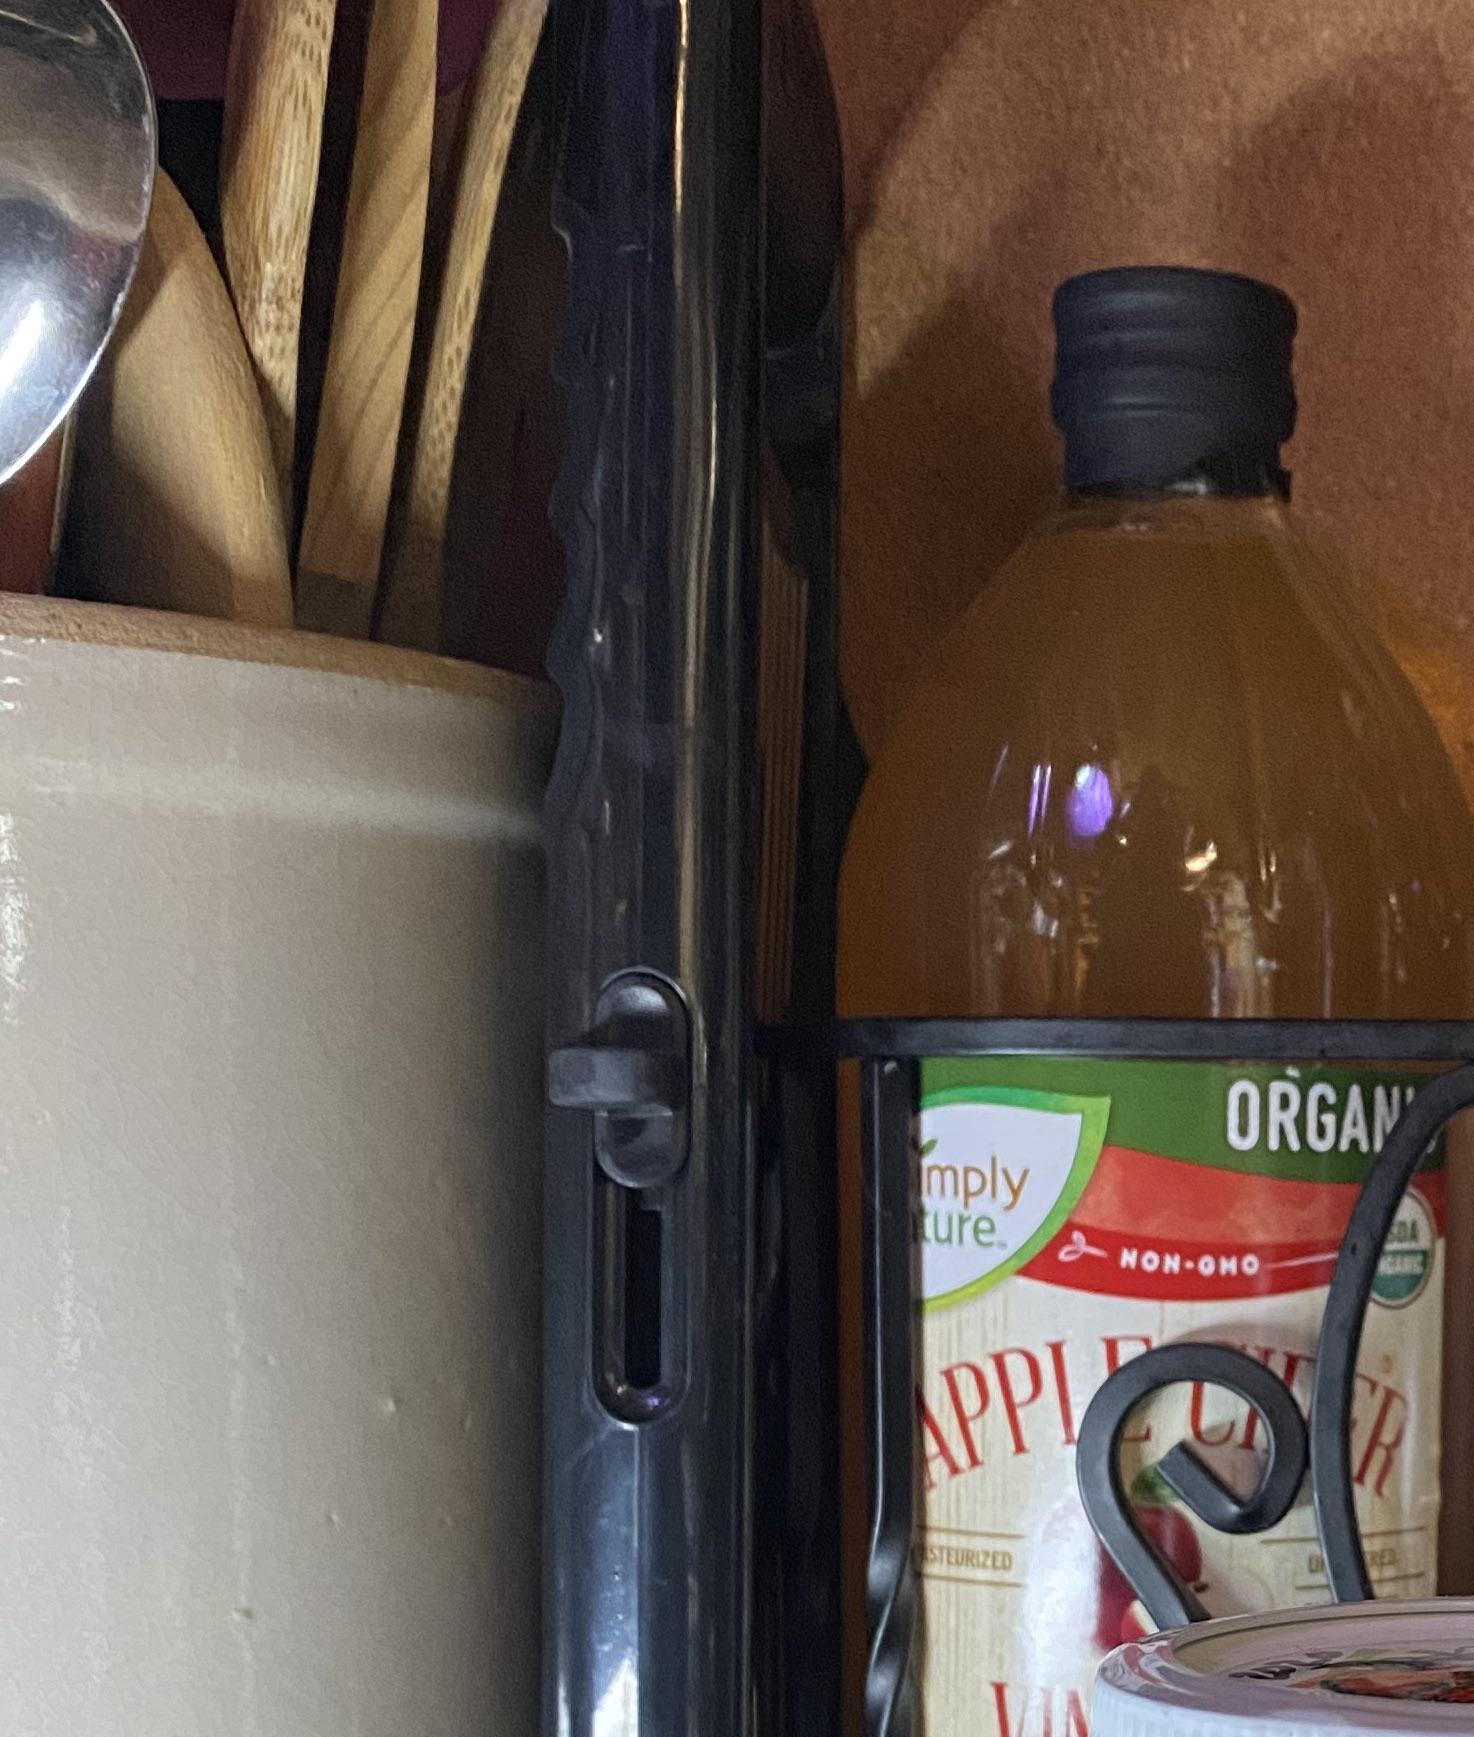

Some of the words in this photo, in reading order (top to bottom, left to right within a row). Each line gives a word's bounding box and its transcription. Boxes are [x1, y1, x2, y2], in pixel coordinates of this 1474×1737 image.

[1227, 1078, 1436, 1154] ORGAN
[926, 1154, 1030, 1213] mply
[921, 1211, 997, 1248] ure
[1118, 1247, 1261, 1278] NON-GMO
[922, 1545, 1013, 1572] STEURIZED
